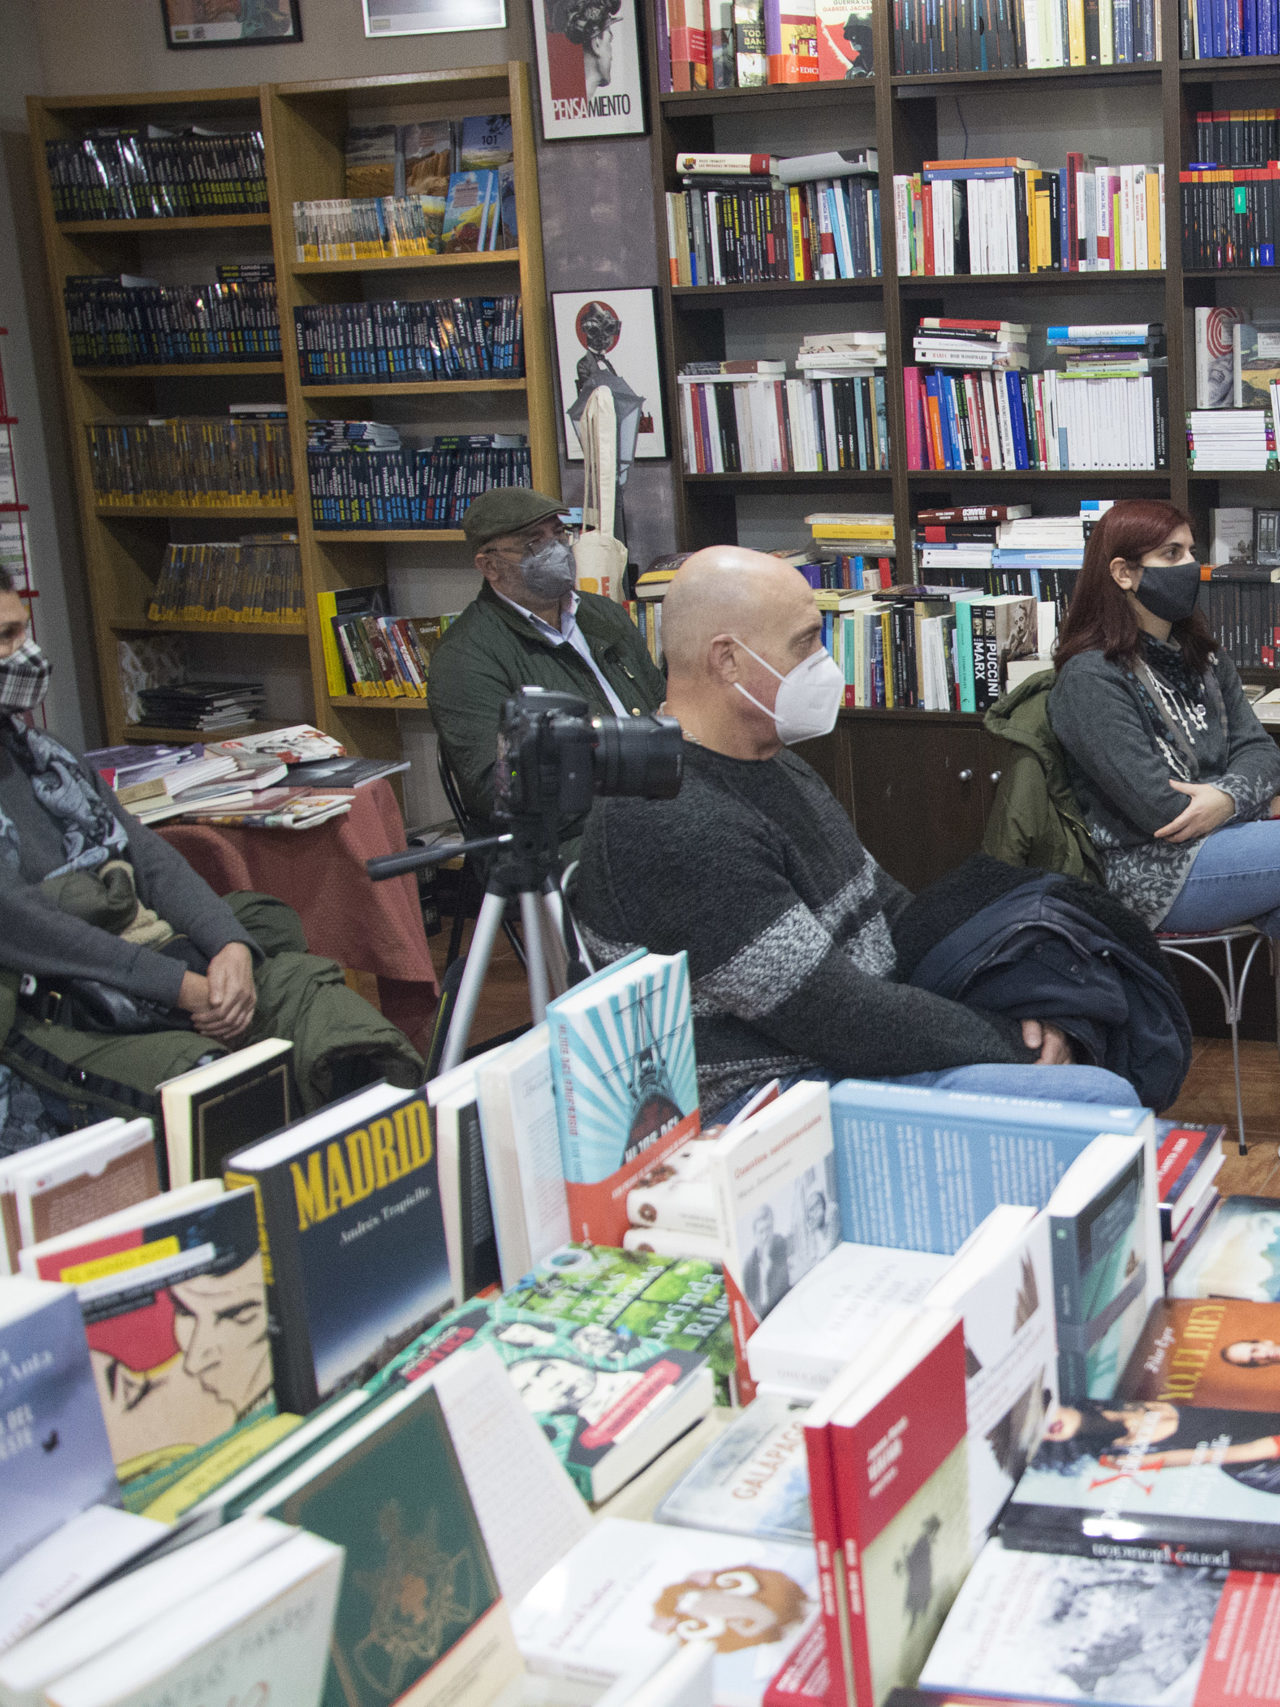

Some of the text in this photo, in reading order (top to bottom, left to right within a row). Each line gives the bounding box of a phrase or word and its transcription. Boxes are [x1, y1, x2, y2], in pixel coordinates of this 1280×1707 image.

[551, 93, 632, 121] PENSAMIENTO
[481, 134, 498, 146] 101
[296, 322, 304, 351] EGIPTO
[962, 508, 987, 516] FRANCO
[973, 642, 985, 680] MARX
[986, 643, 999, 697] PUCCINI
[289, 1099, 432, 1232] MADRID
[339, 1185, 431, 1247] Andrés Trapiello
[651, 1273, 724, 1343] Lucinda
[682, 1292, 730, 1337] Rile
[1183, 1304, 1227, 1340] REY
[1172, 1340, 1213, 1369] EL
